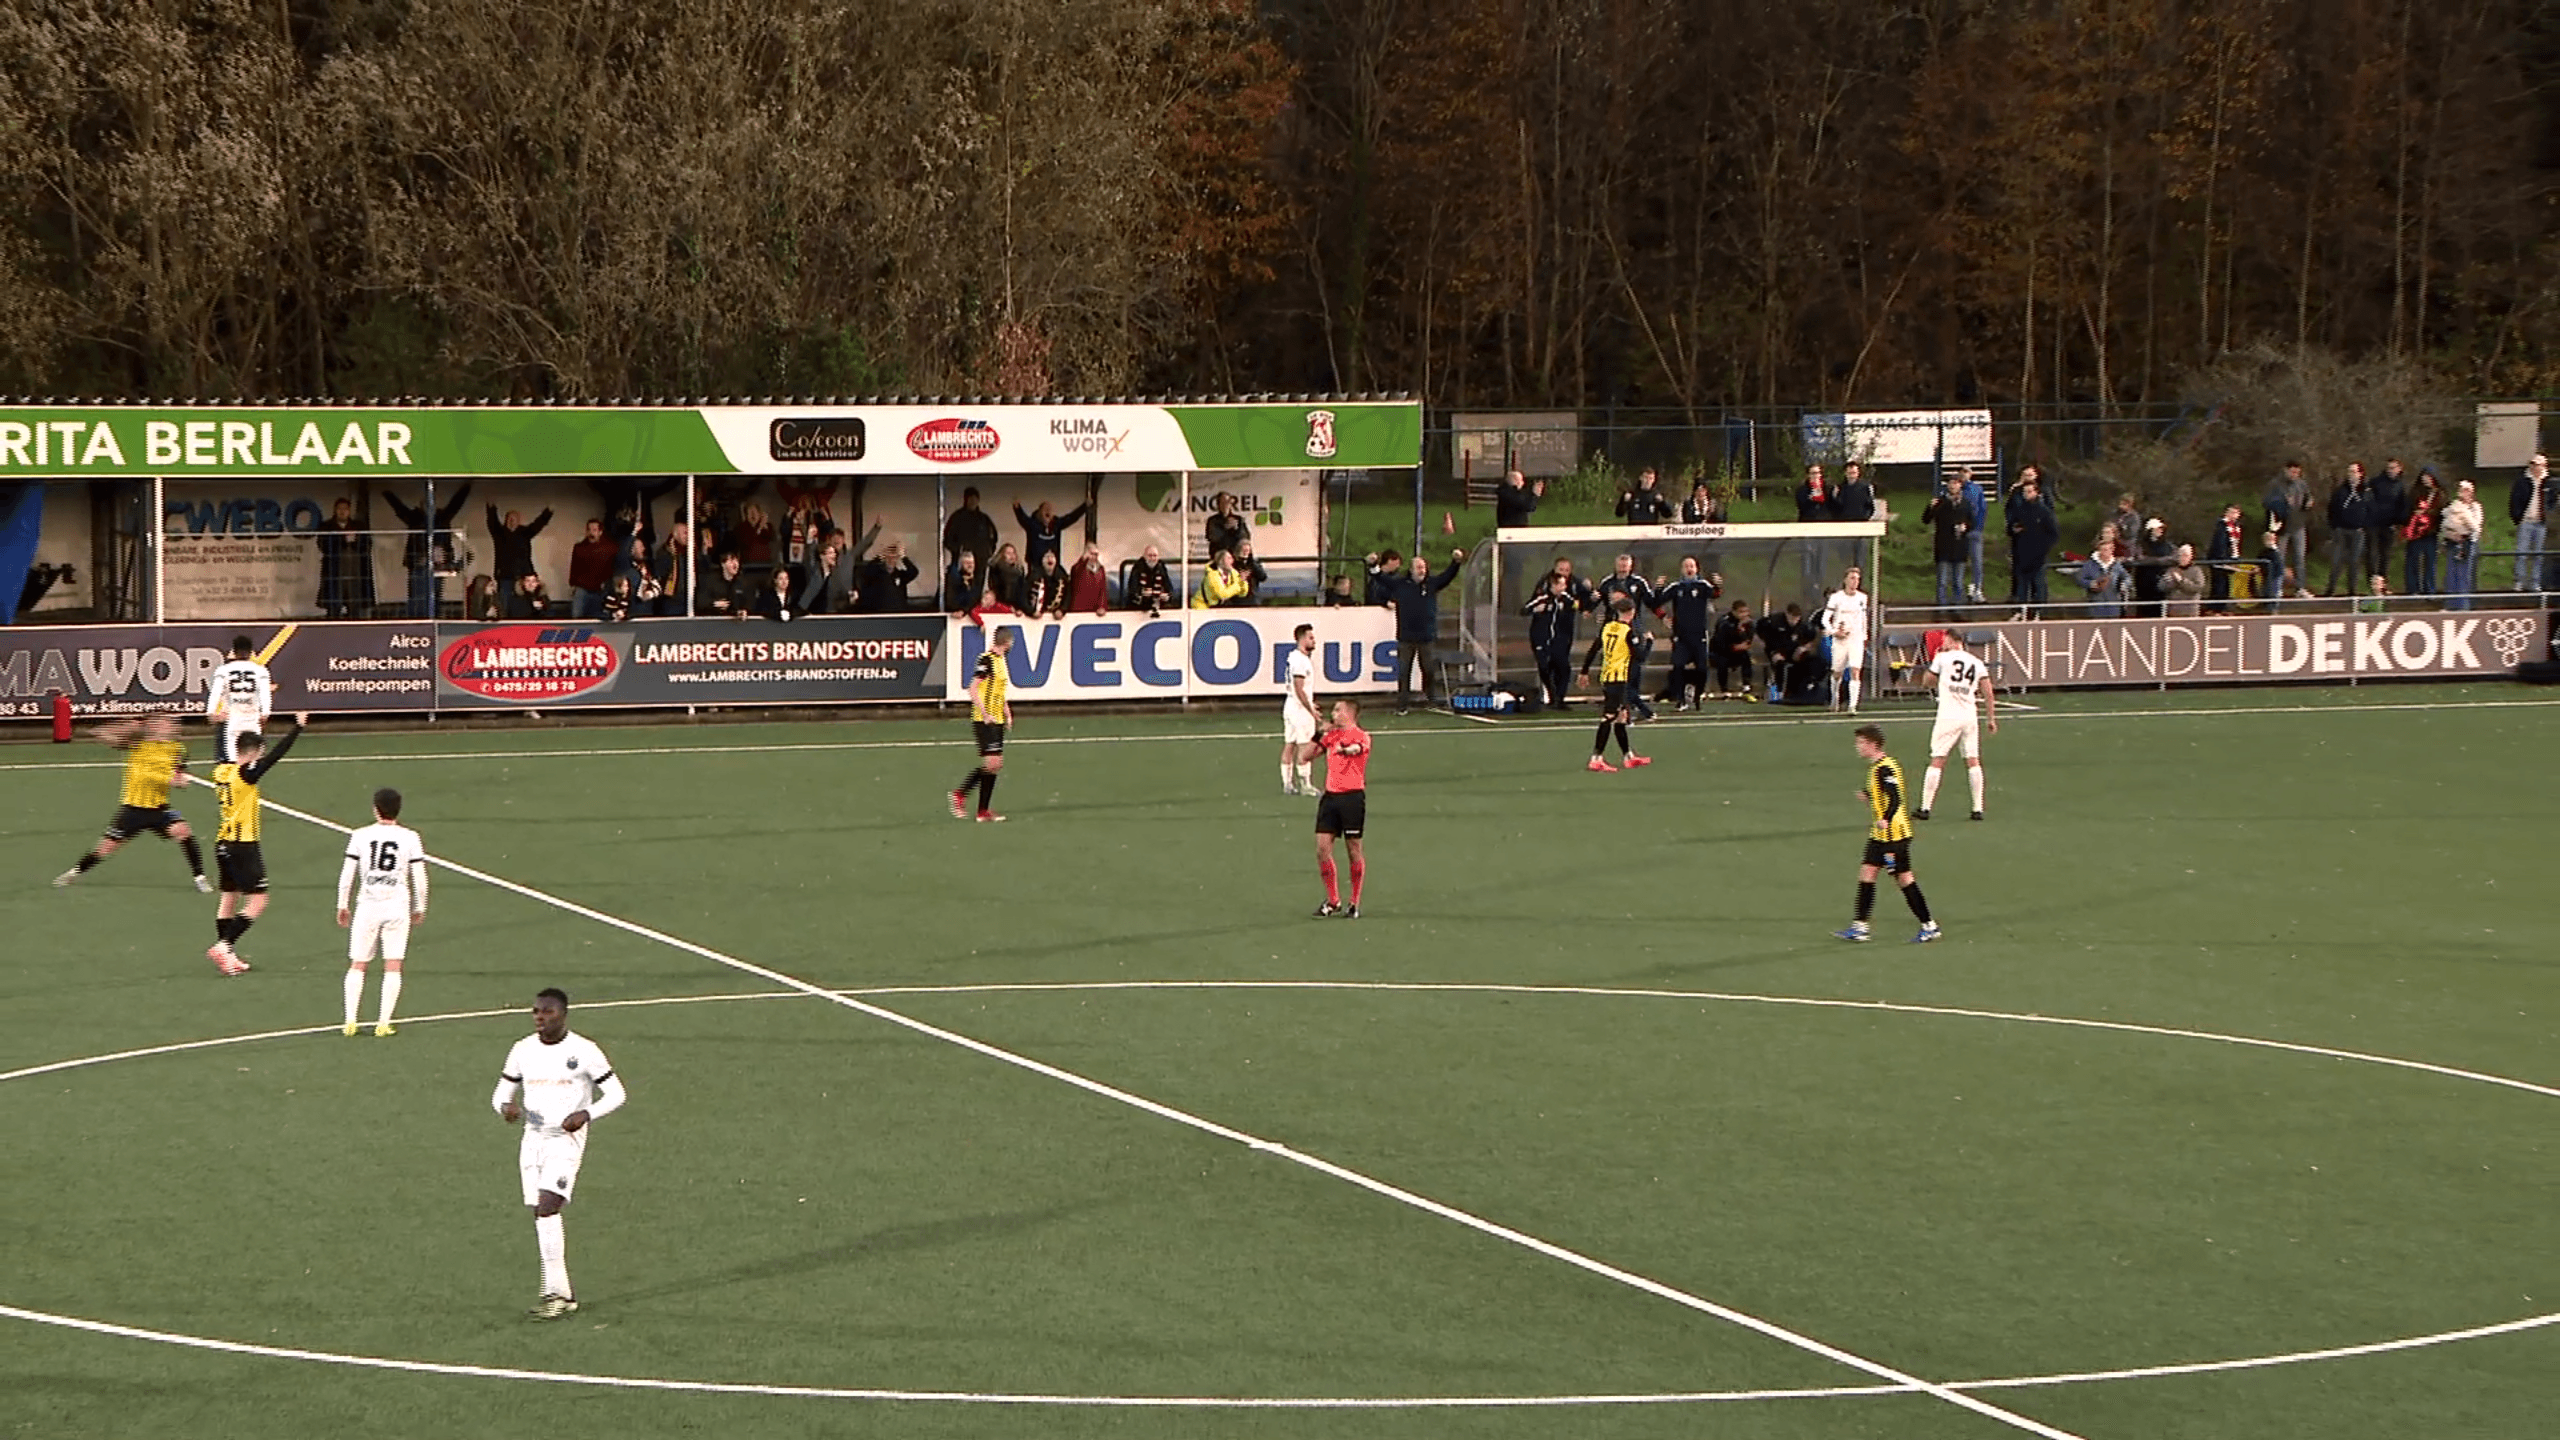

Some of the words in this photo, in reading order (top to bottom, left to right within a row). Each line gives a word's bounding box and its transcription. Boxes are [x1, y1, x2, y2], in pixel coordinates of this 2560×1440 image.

[1050, 418, 1108, 435] KLIMA
[0, 421, 127, 466] RITA
[145, 421, 412, 466] BERLAAR
[923, 431, 995, 444] LAMBRECHTS
[1664, 525, 1726, 536] Thuisploeg
[390, 634, 431, 648] Airco
[473, 646, 609, 669] LAMBRECHTS
[634, 642, 768, 663] LAMBRECHTS
[773, 639, 930, 661] BRANDSTOFFEN
[961, 619, 1262, 689] IVECO
[328, 656, 430, 671] Koeltechniek
[229, 670, 256, 693] 25
[667, 667, 898, 683] www.LAMBRECHTS-BRANDSTOFFEN.be
[1950, 660, 1976, 686] 34
[305, 678, 431, 694] Warmtepompen
[19, 702, 40, 715] 43
[69, 699, 206, 714] ww.klimaworx.be
[369, 840, 399, 872] 16
